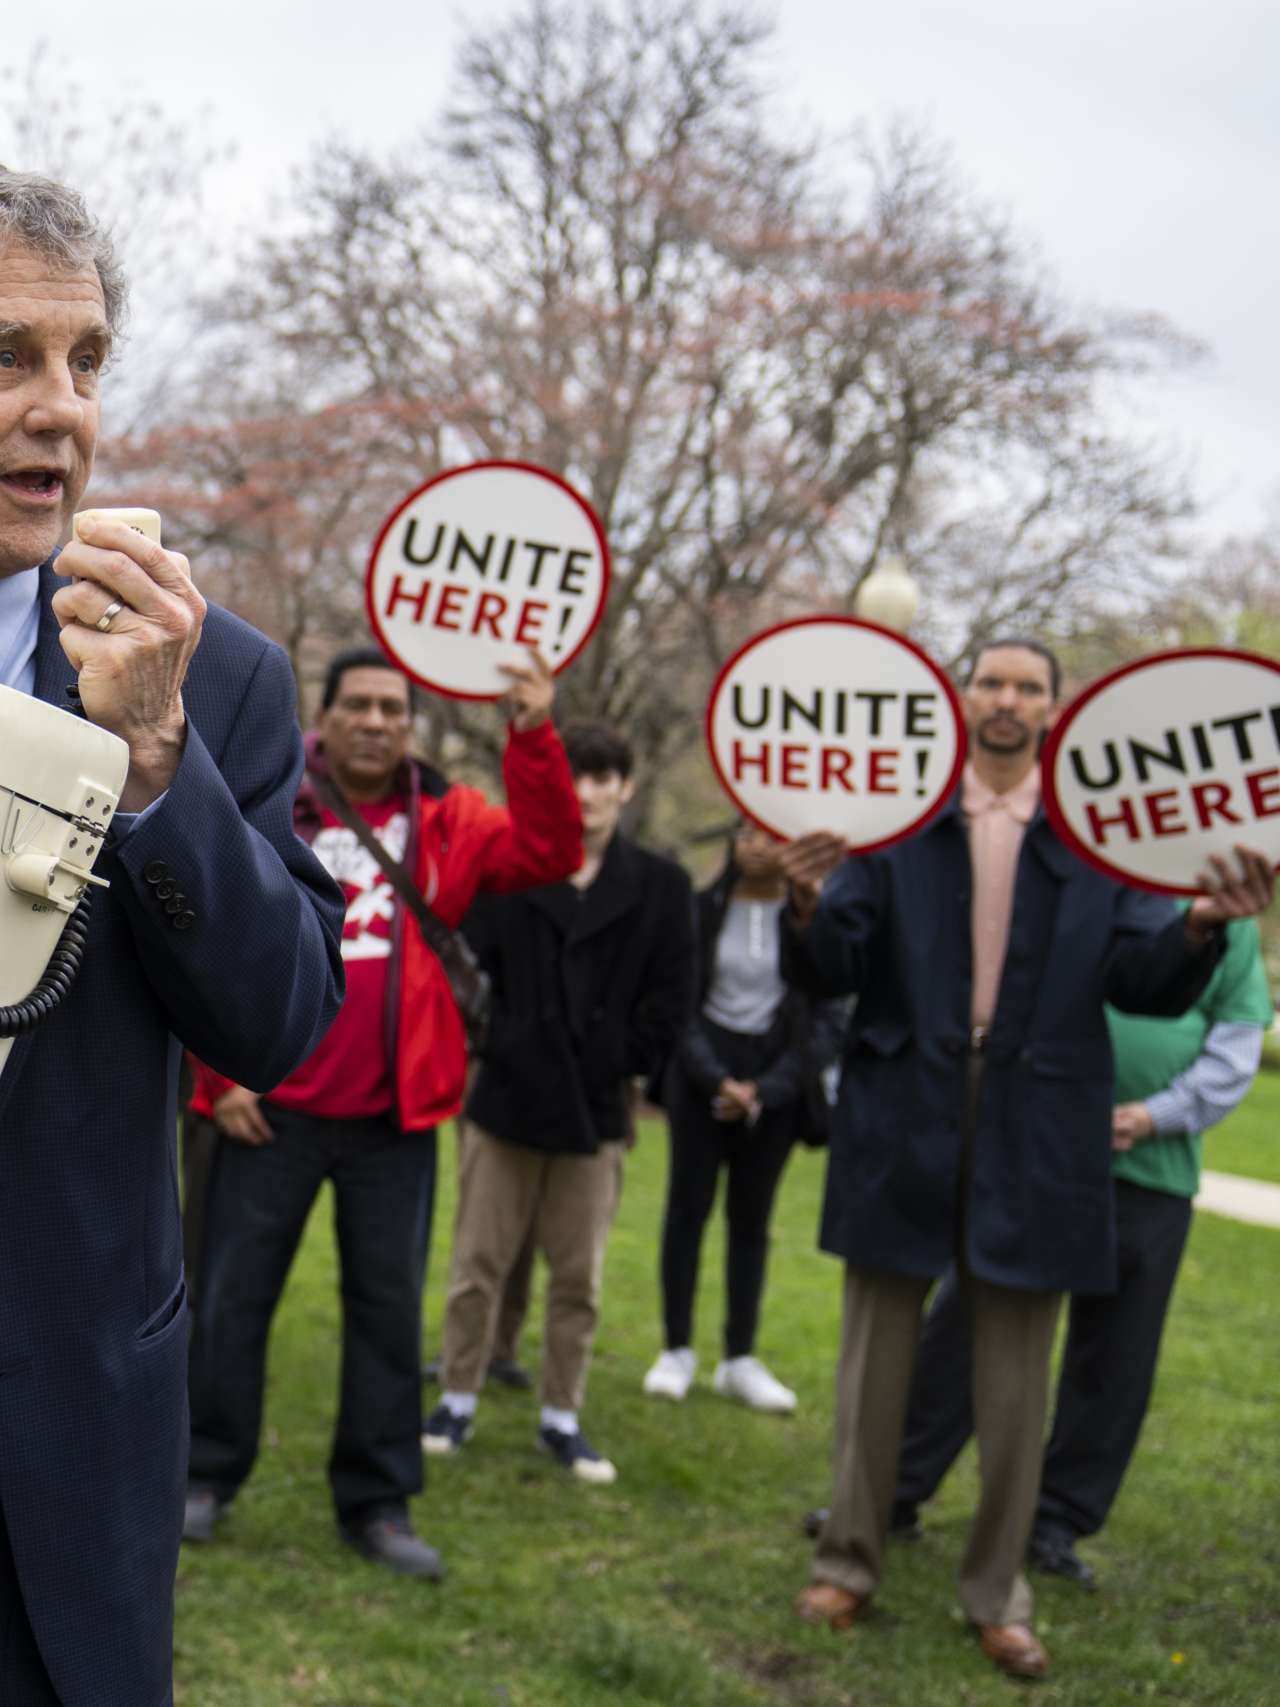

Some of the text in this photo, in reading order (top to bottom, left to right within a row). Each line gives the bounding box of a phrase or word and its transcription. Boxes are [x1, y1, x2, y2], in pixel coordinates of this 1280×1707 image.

[400, 517, 594, 597] UNITE
[383, 573, 575, 653] HERE!
[730, 683, 938, 740] UNITE
[731, 740, 928, 796] HERE!
